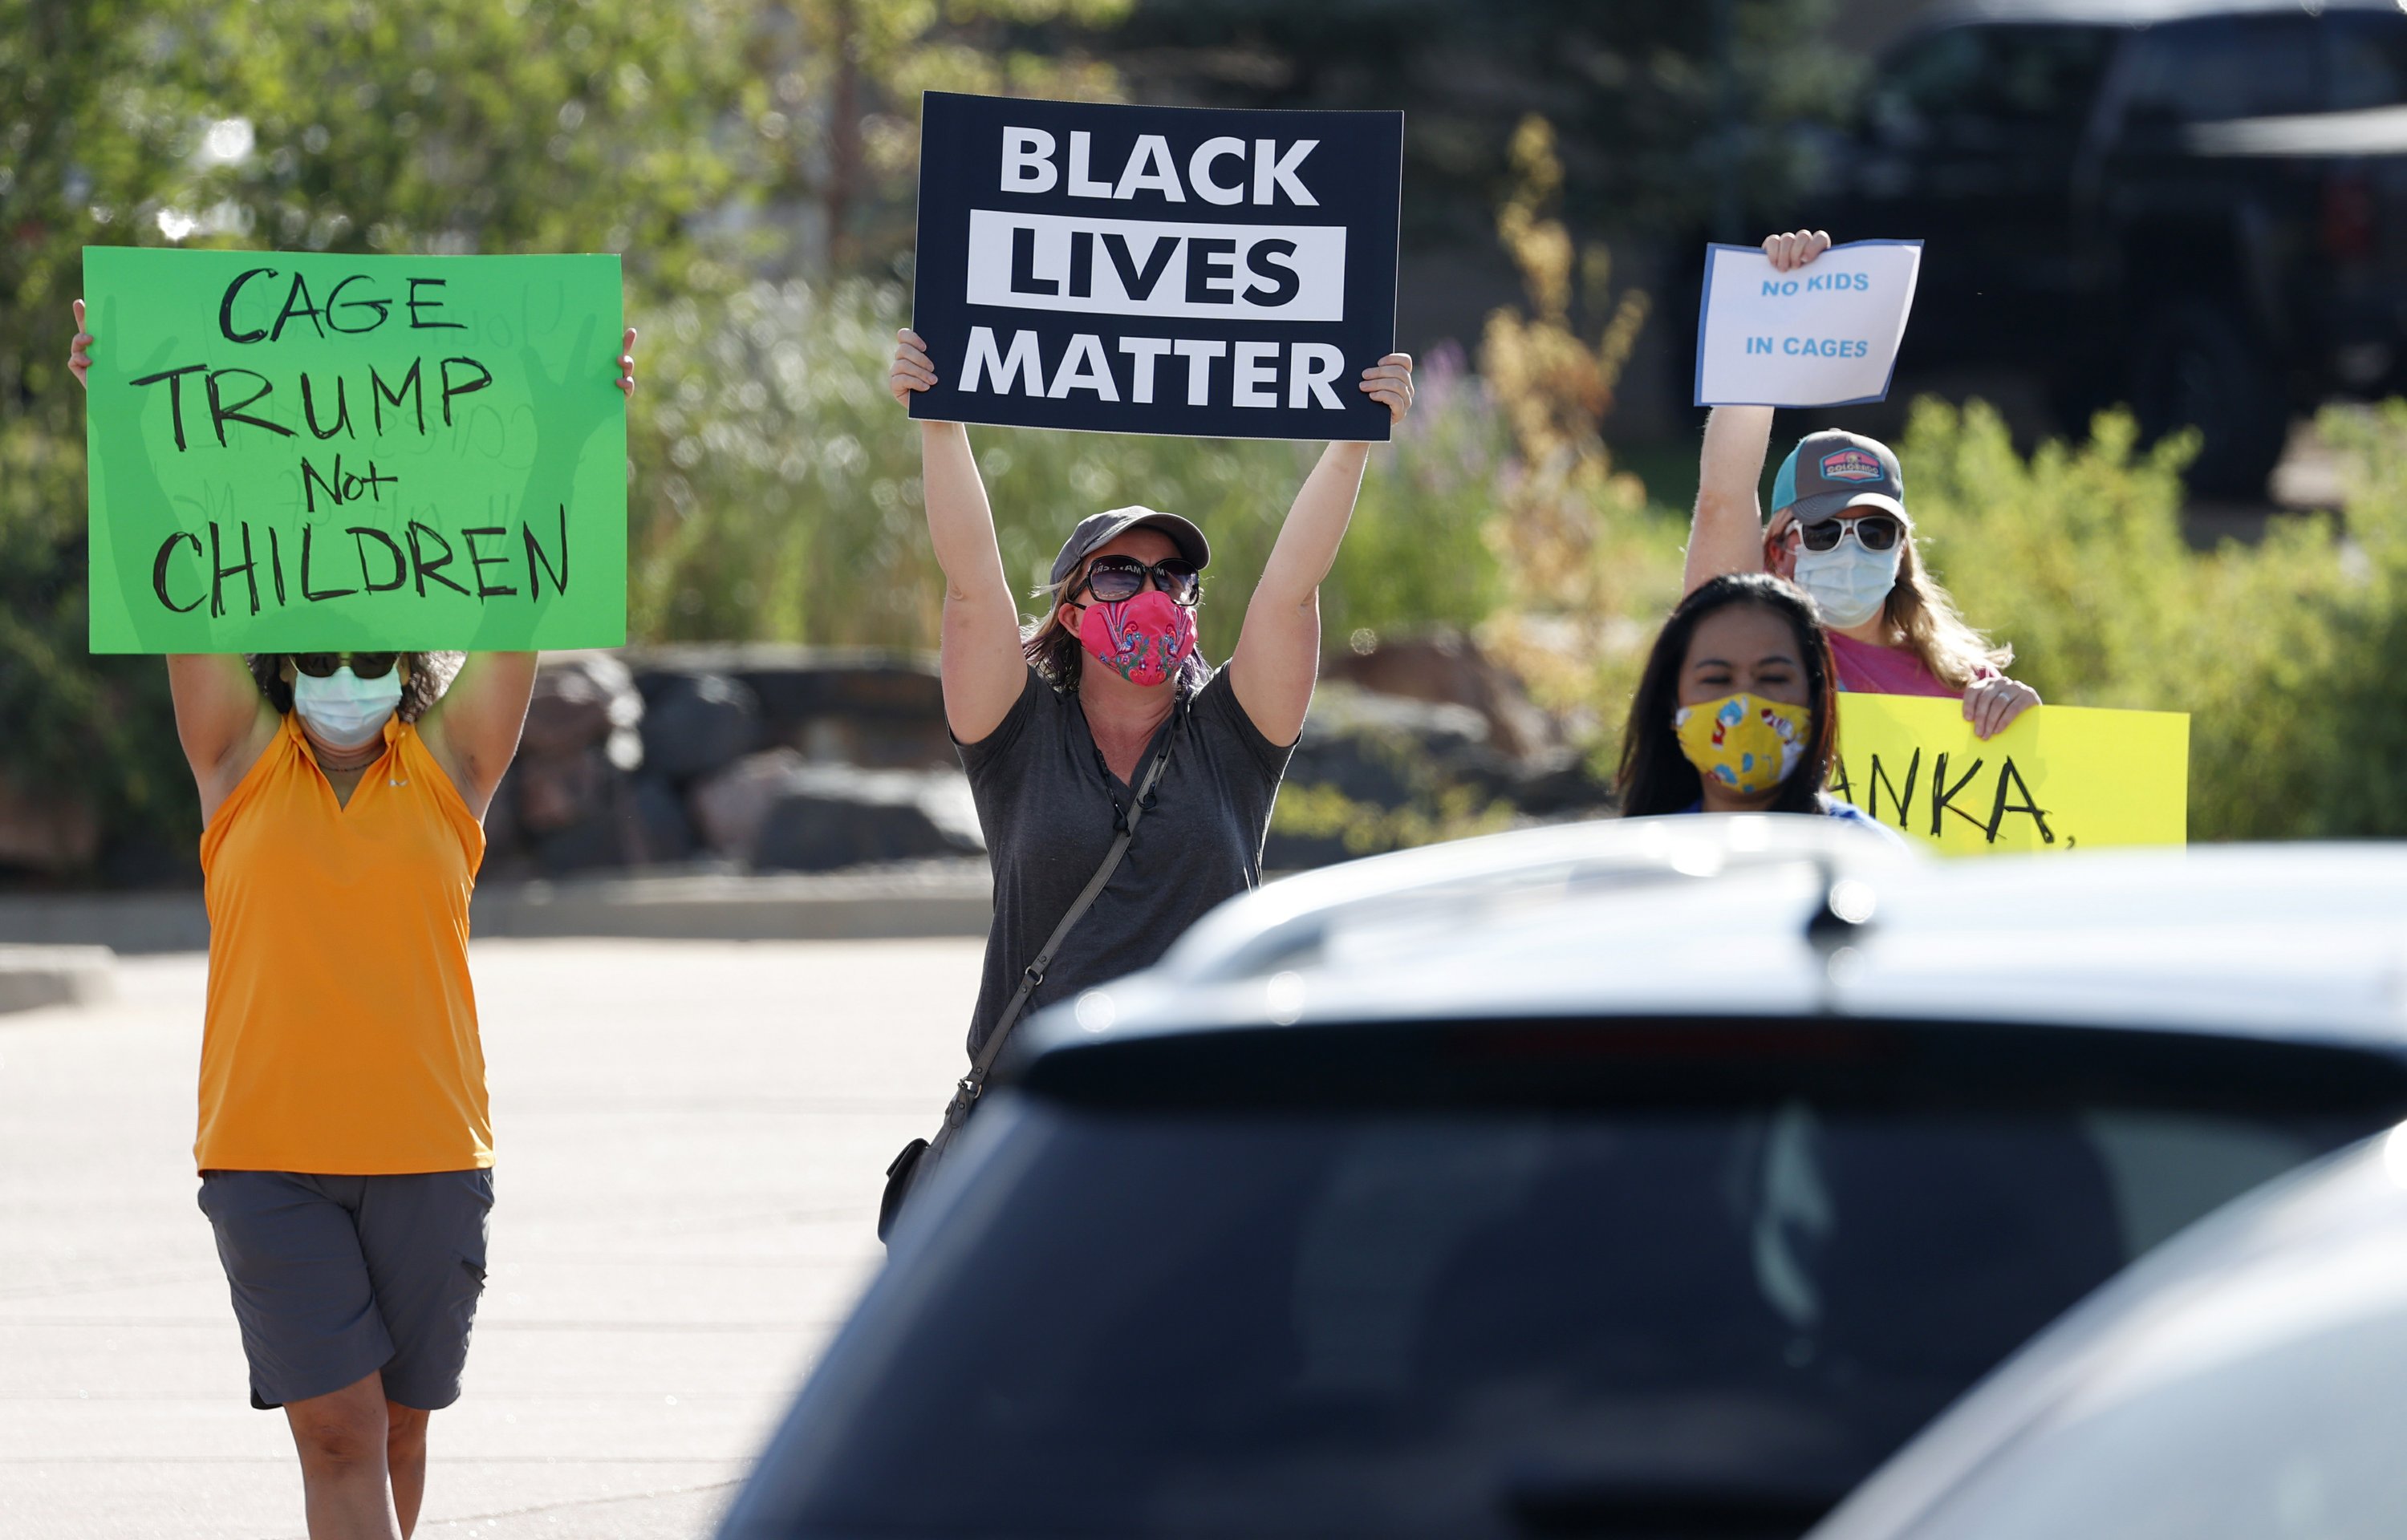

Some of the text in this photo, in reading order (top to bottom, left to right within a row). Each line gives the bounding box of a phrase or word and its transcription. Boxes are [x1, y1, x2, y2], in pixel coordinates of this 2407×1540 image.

[1001, 125, 1321, 207] BLACK
[218, 268, 469, 344] CAGE
[1010, 227, 1301, 307] LIVES
[1760, 272, 1869, 297] NO KIDS
[958, 326, 1347, 411] MATTER
[1746, 336, 1869, 359] IN CAGES
[128, 356, 493, 452] TRUMP
[152, 504, 568, 618] CHILDREN
